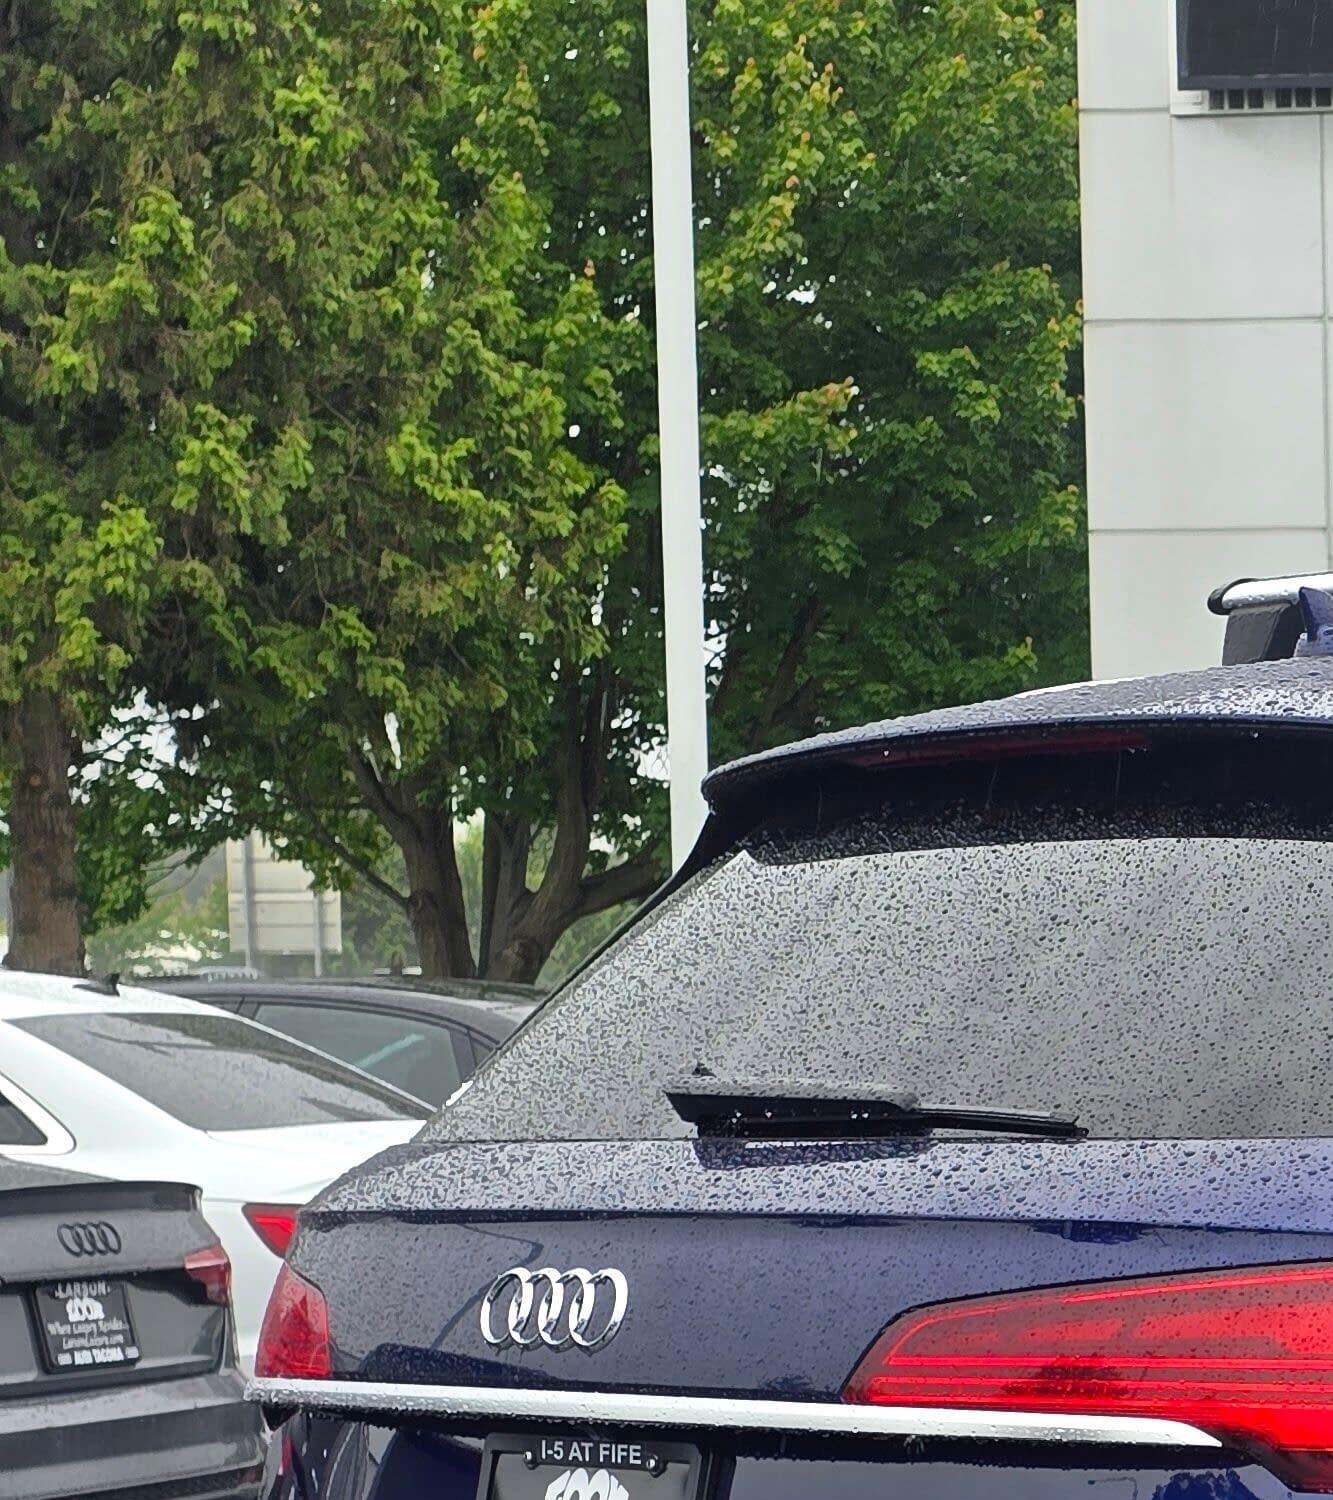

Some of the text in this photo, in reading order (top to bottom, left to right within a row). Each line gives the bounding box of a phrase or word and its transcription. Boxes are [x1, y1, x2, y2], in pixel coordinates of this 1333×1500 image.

[541, 1439, 642, 1465] I-5 AT FIFE
